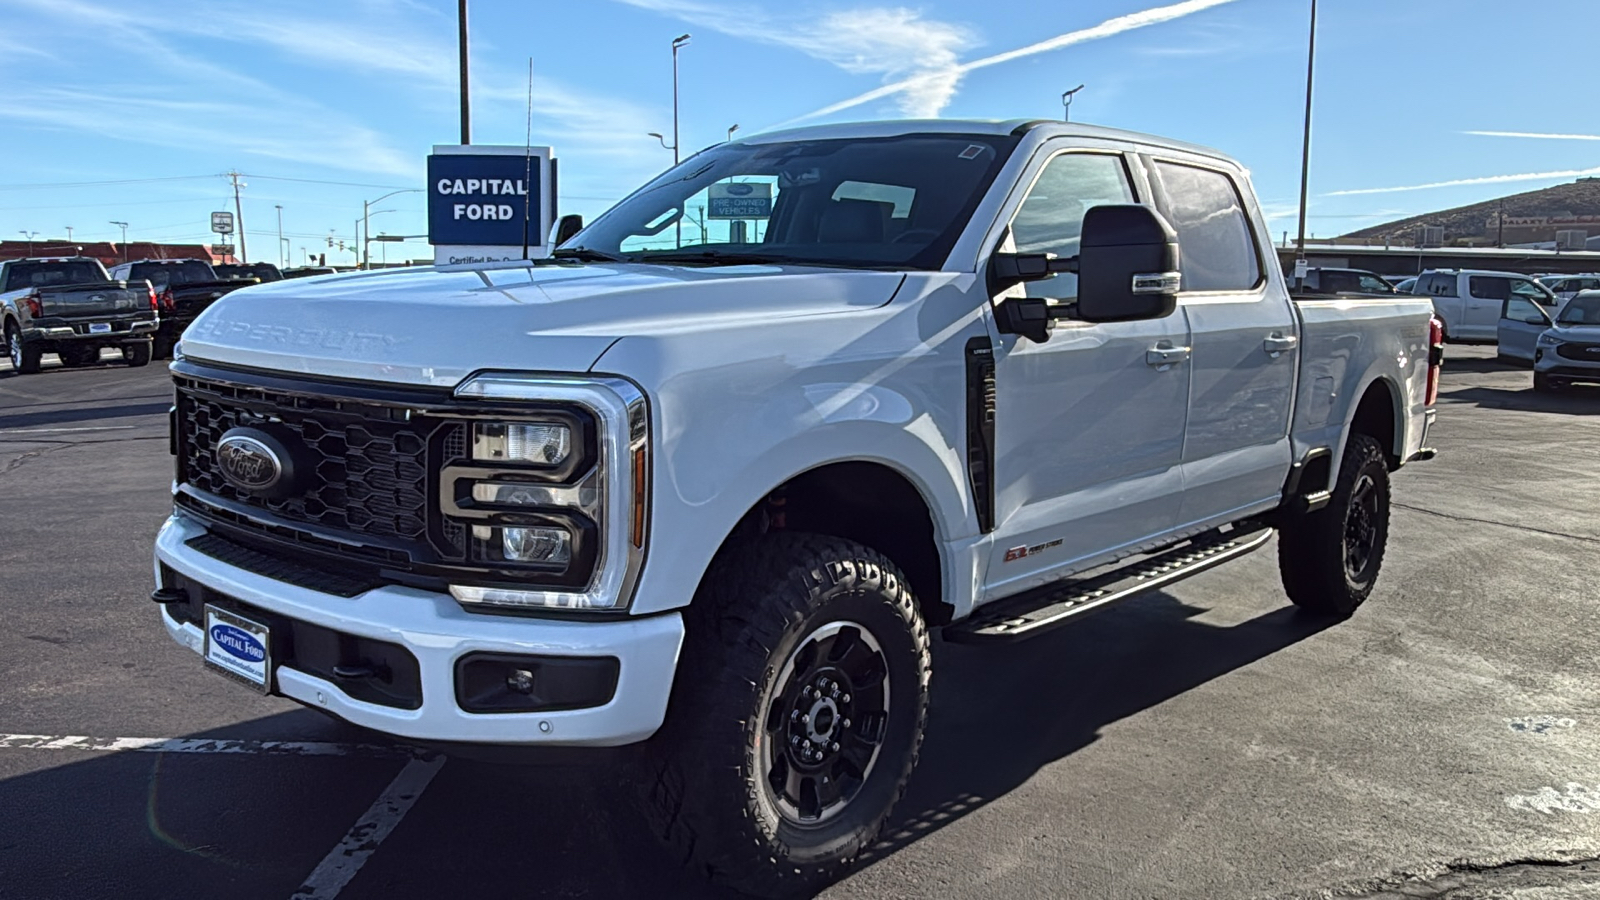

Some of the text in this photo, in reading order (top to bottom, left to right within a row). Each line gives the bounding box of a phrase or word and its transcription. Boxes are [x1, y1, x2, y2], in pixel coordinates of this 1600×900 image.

[437, 178, 528, 195] CAPITAL
[713, 199, 766, 207] PRE-OWNED
[718, 207, 760, 215] VEHICLES
[453, 204, 514, 220] FORD
[213, 629, 244, 651] CAPITAL
[244, 641, 264, 659] FORD
